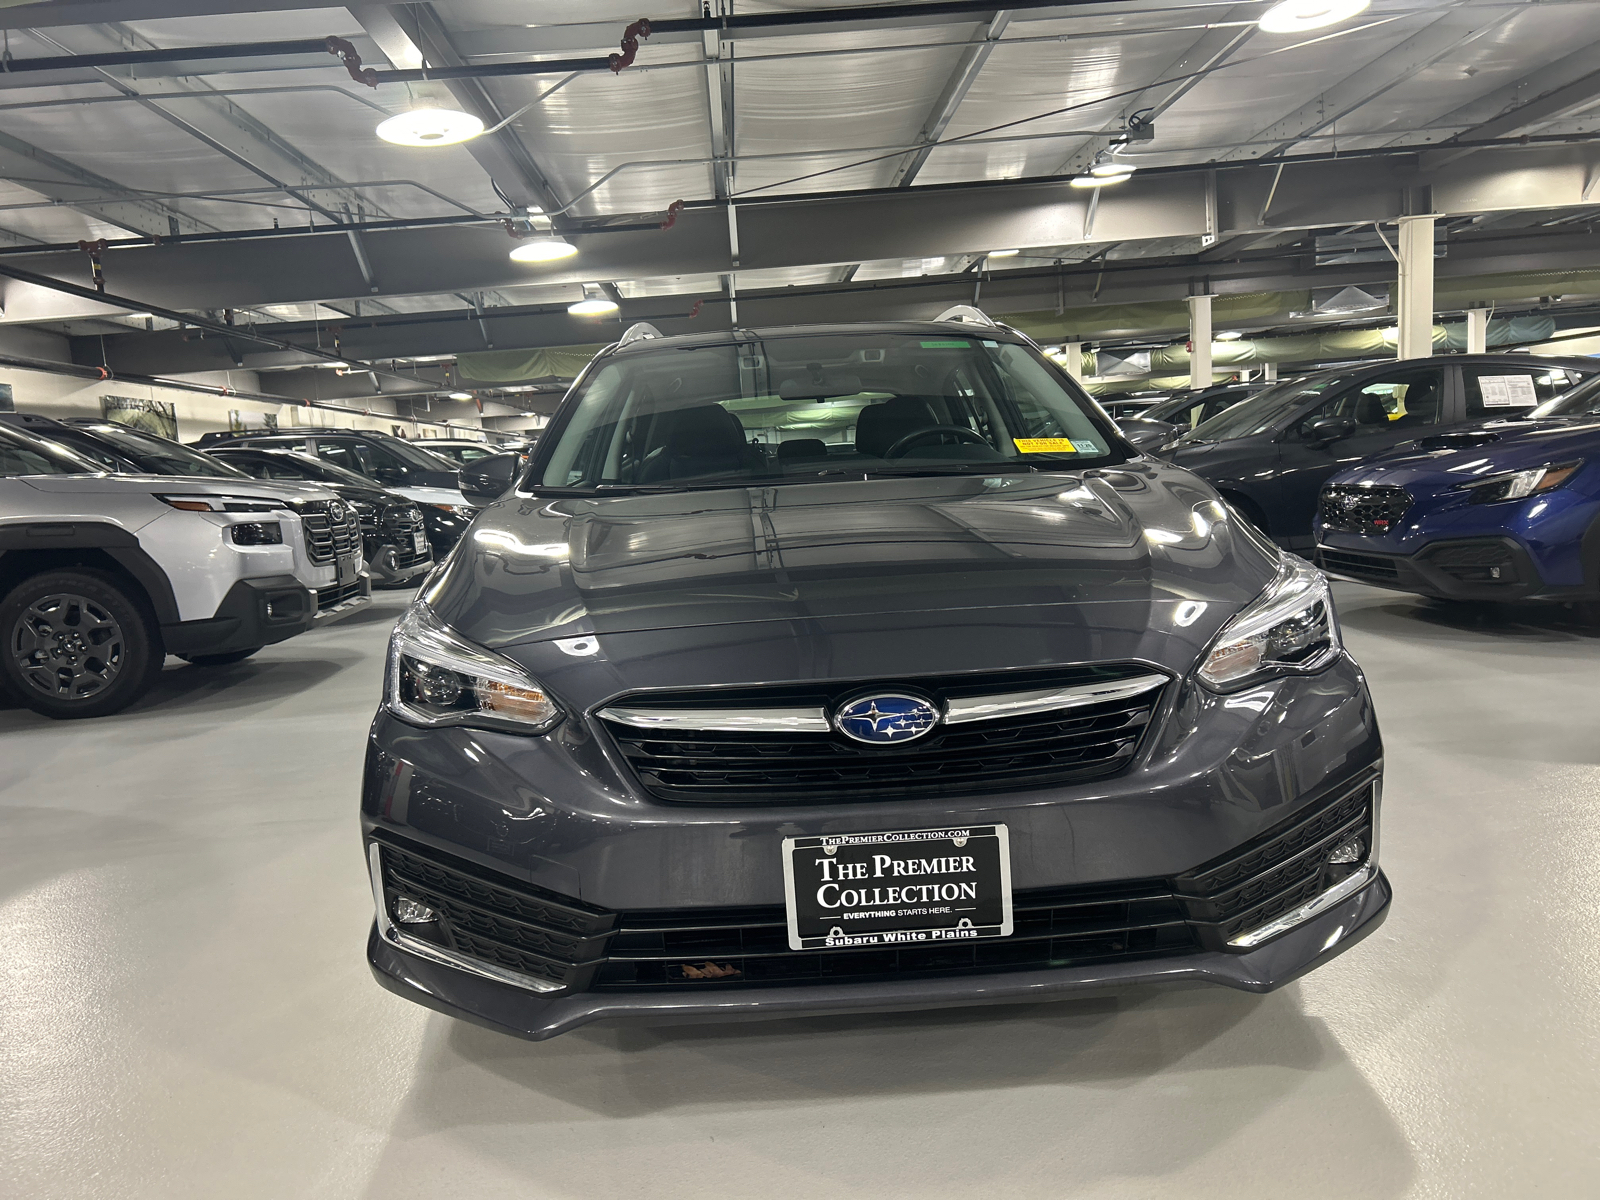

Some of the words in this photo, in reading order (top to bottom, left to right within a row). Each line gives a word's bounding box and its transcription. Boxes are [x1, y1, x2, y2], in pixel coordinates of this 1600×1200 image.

[843, 910, 896, 920] EVERYTHING
[897, 907, 928, 917] STARTS
[928, 906, 953, 915] HERE.
[825, 936, 878, 947] Subaru
[882, 932, 927, 943] White
[931, 928, 978, 940] Plains
